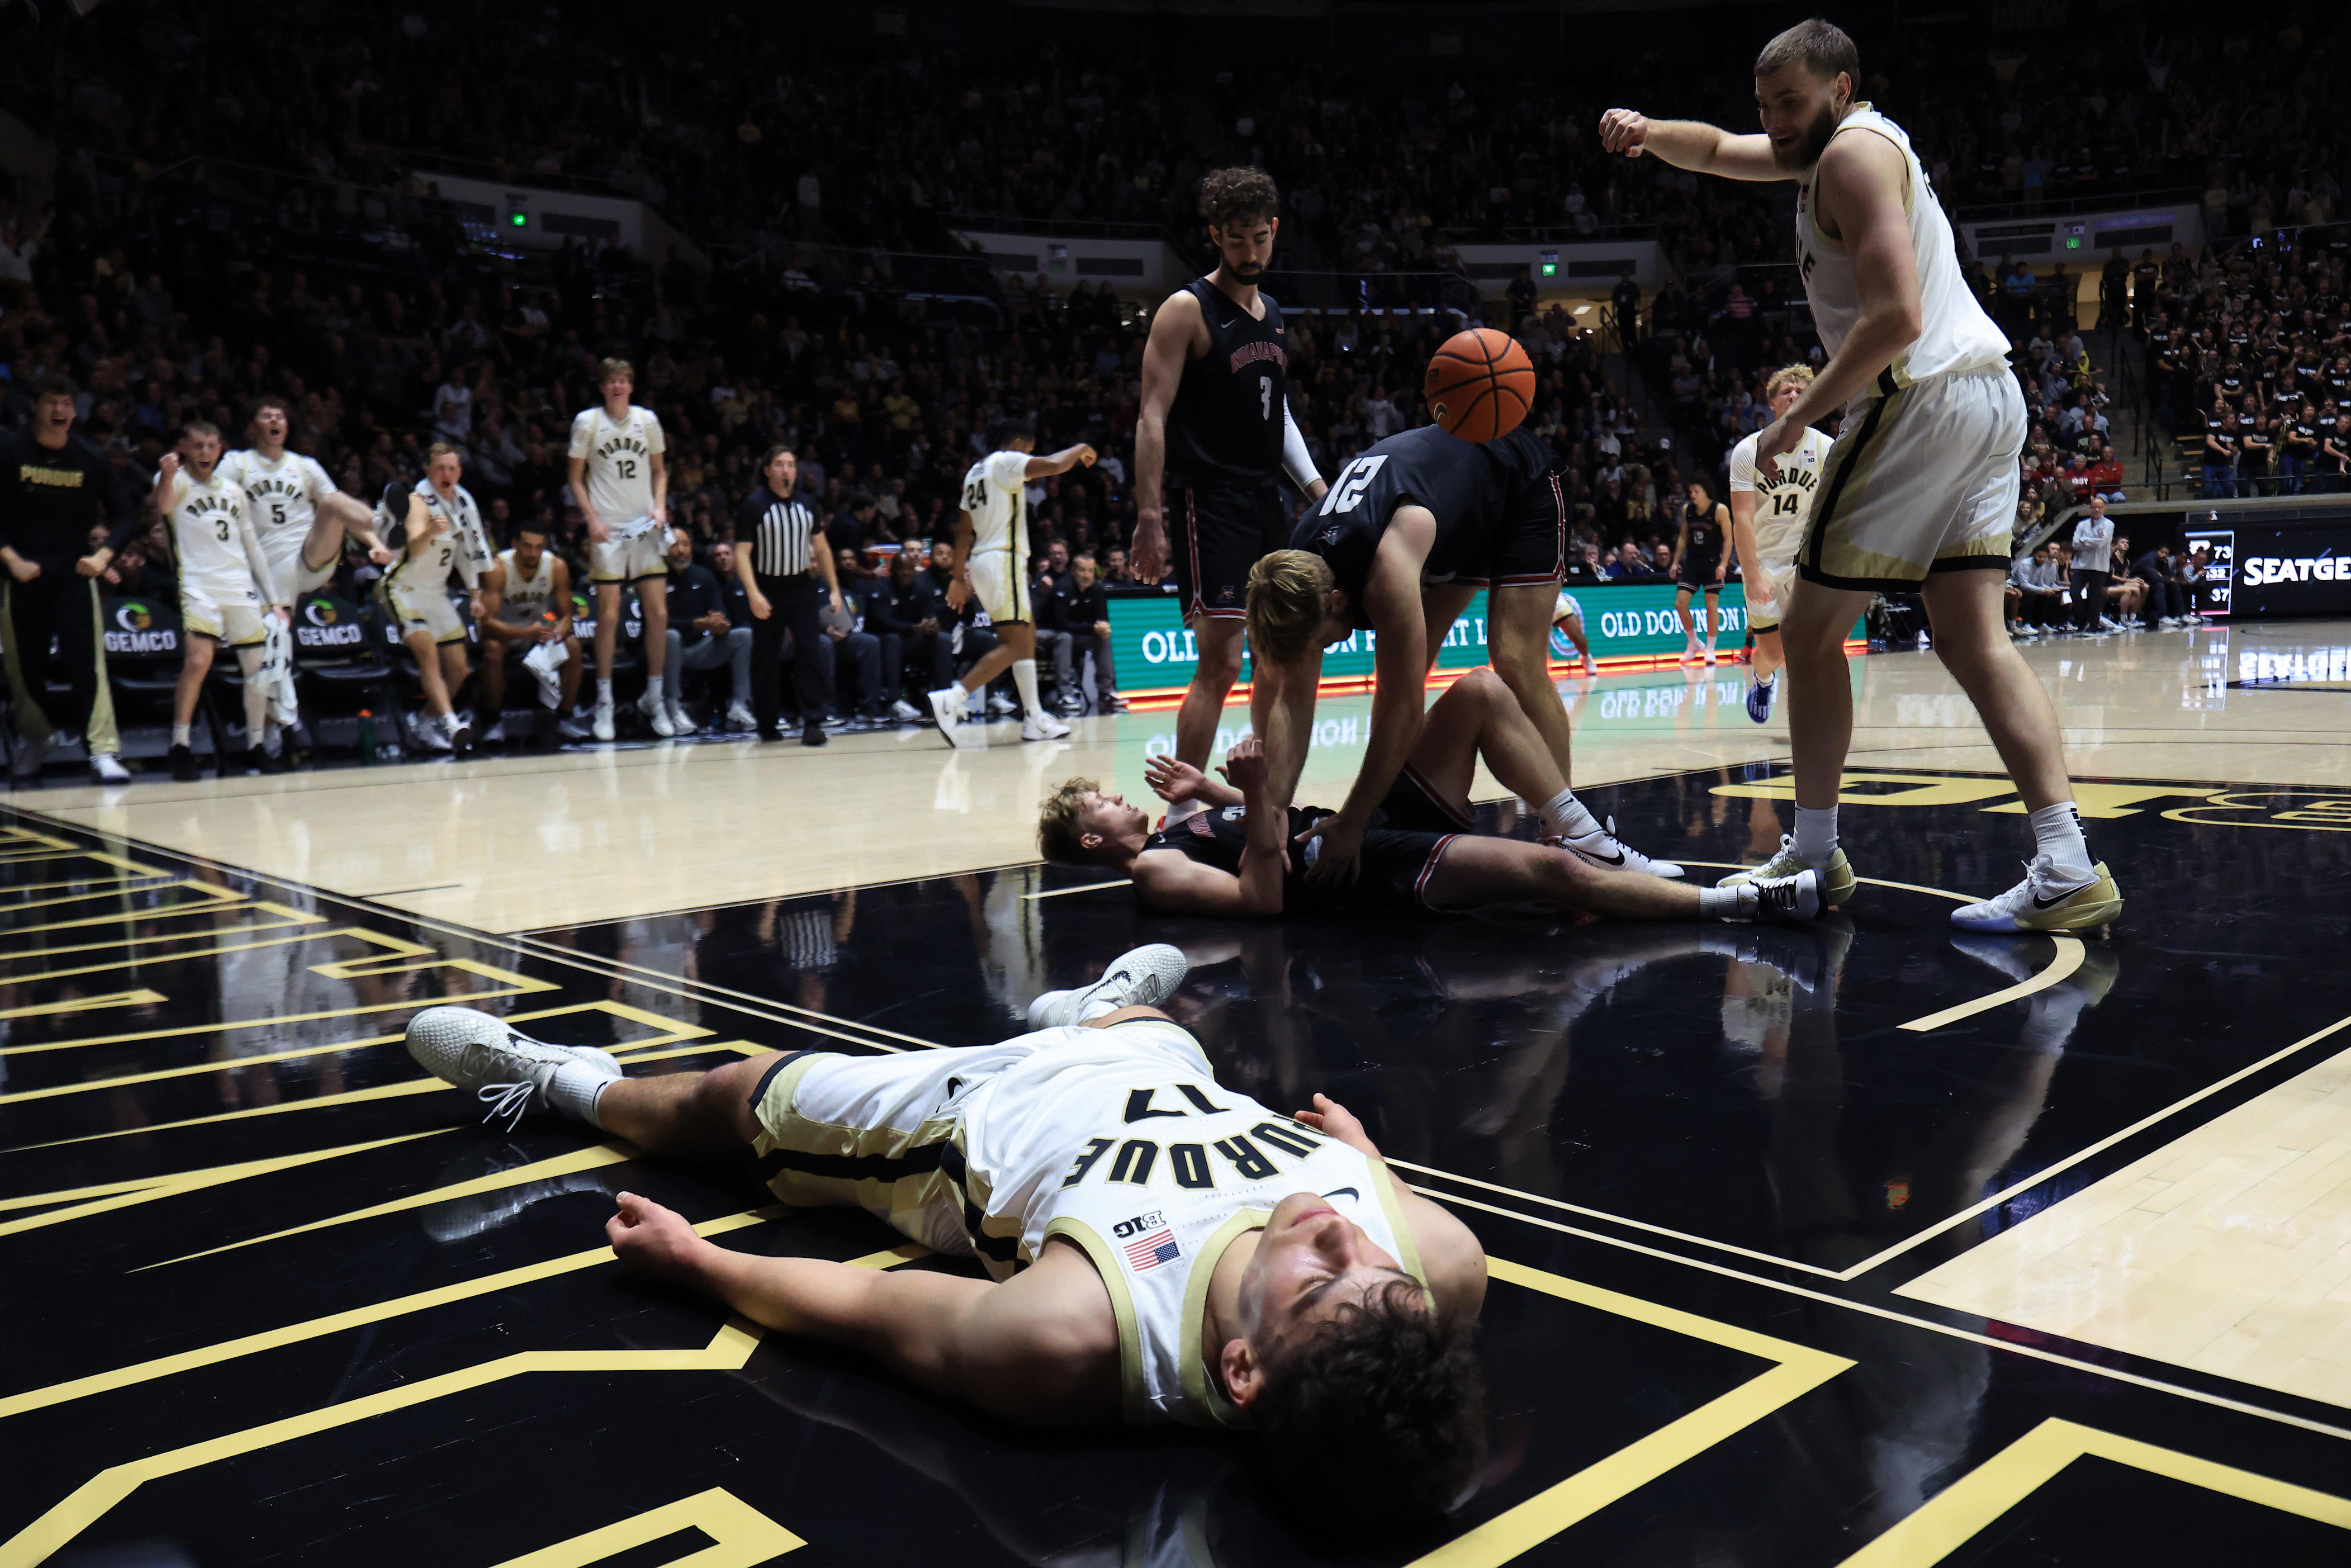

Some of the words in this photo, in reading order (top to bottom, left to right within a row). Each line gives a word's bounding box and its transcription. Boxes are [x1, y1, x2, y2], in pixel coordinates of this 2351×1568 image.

[1259, 376, 1272, 420] 3
[597, 437, 647, 459] PURDUE
[616, 460, 636, 479] 12
[1756, 466, 1817, 495] PURDUE
[245, 479, 303, 503] PURDUE
[966, 479, 987, 510] 24
[186, 495, 240, 519] PURDU
[272, 503, 287, 524] 5
[1773, 493, 1798, 515] 14
[215, 519, 229, 542] 3
[439, 548, 451, 567] 2
[2213, 545, 2231, 559] 73
[2243, 556, 2351, 586] SEATGE
[2211, 588, 2230, 602] 37
[1601, 611, 1642, 638] OLD
[1644, 605, 1740, 636] DOMNON
[104, 629, 177, 653] GEMCO
[296, 623, 363, 646] GEMCO
[1121, 1083, 1233, 1125] 17
[1113, 1210, 1167, 1239] B1G
